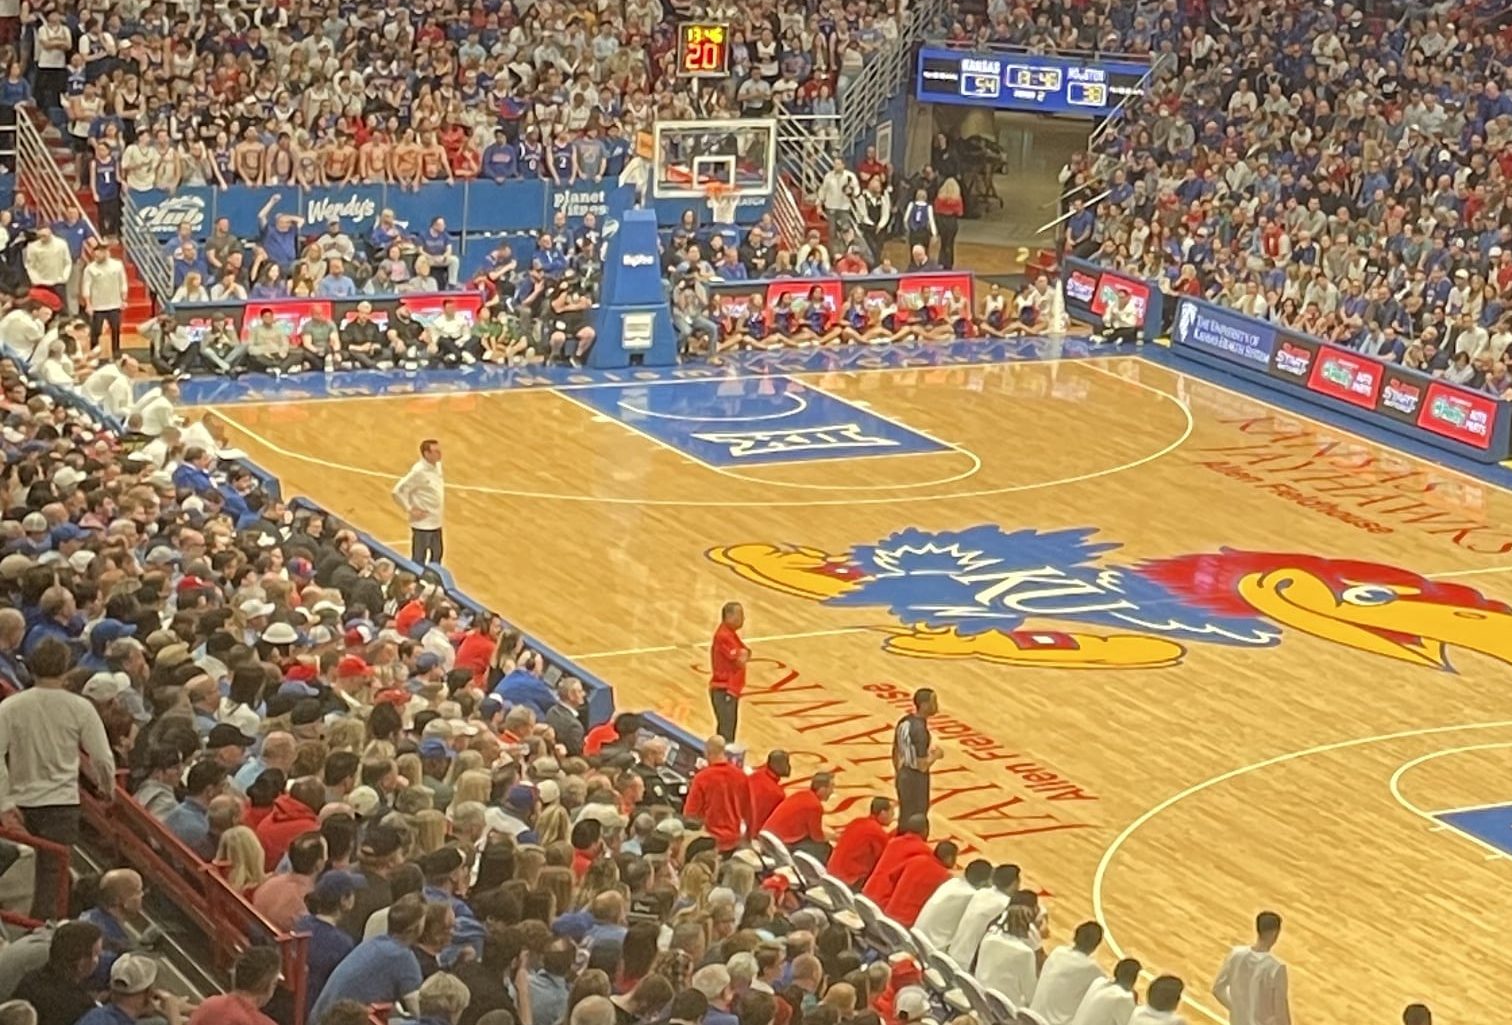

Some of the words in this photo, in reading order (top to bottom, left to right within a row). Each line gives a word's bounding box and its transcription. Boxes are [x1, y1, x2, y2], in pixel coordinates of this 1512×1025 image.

[685, 43, 719, 70] 20
[308, 194, 376, 223] Wendy's
[554, 189, 605, 208] planet
[1005, 752, 1099, 803] Allen
